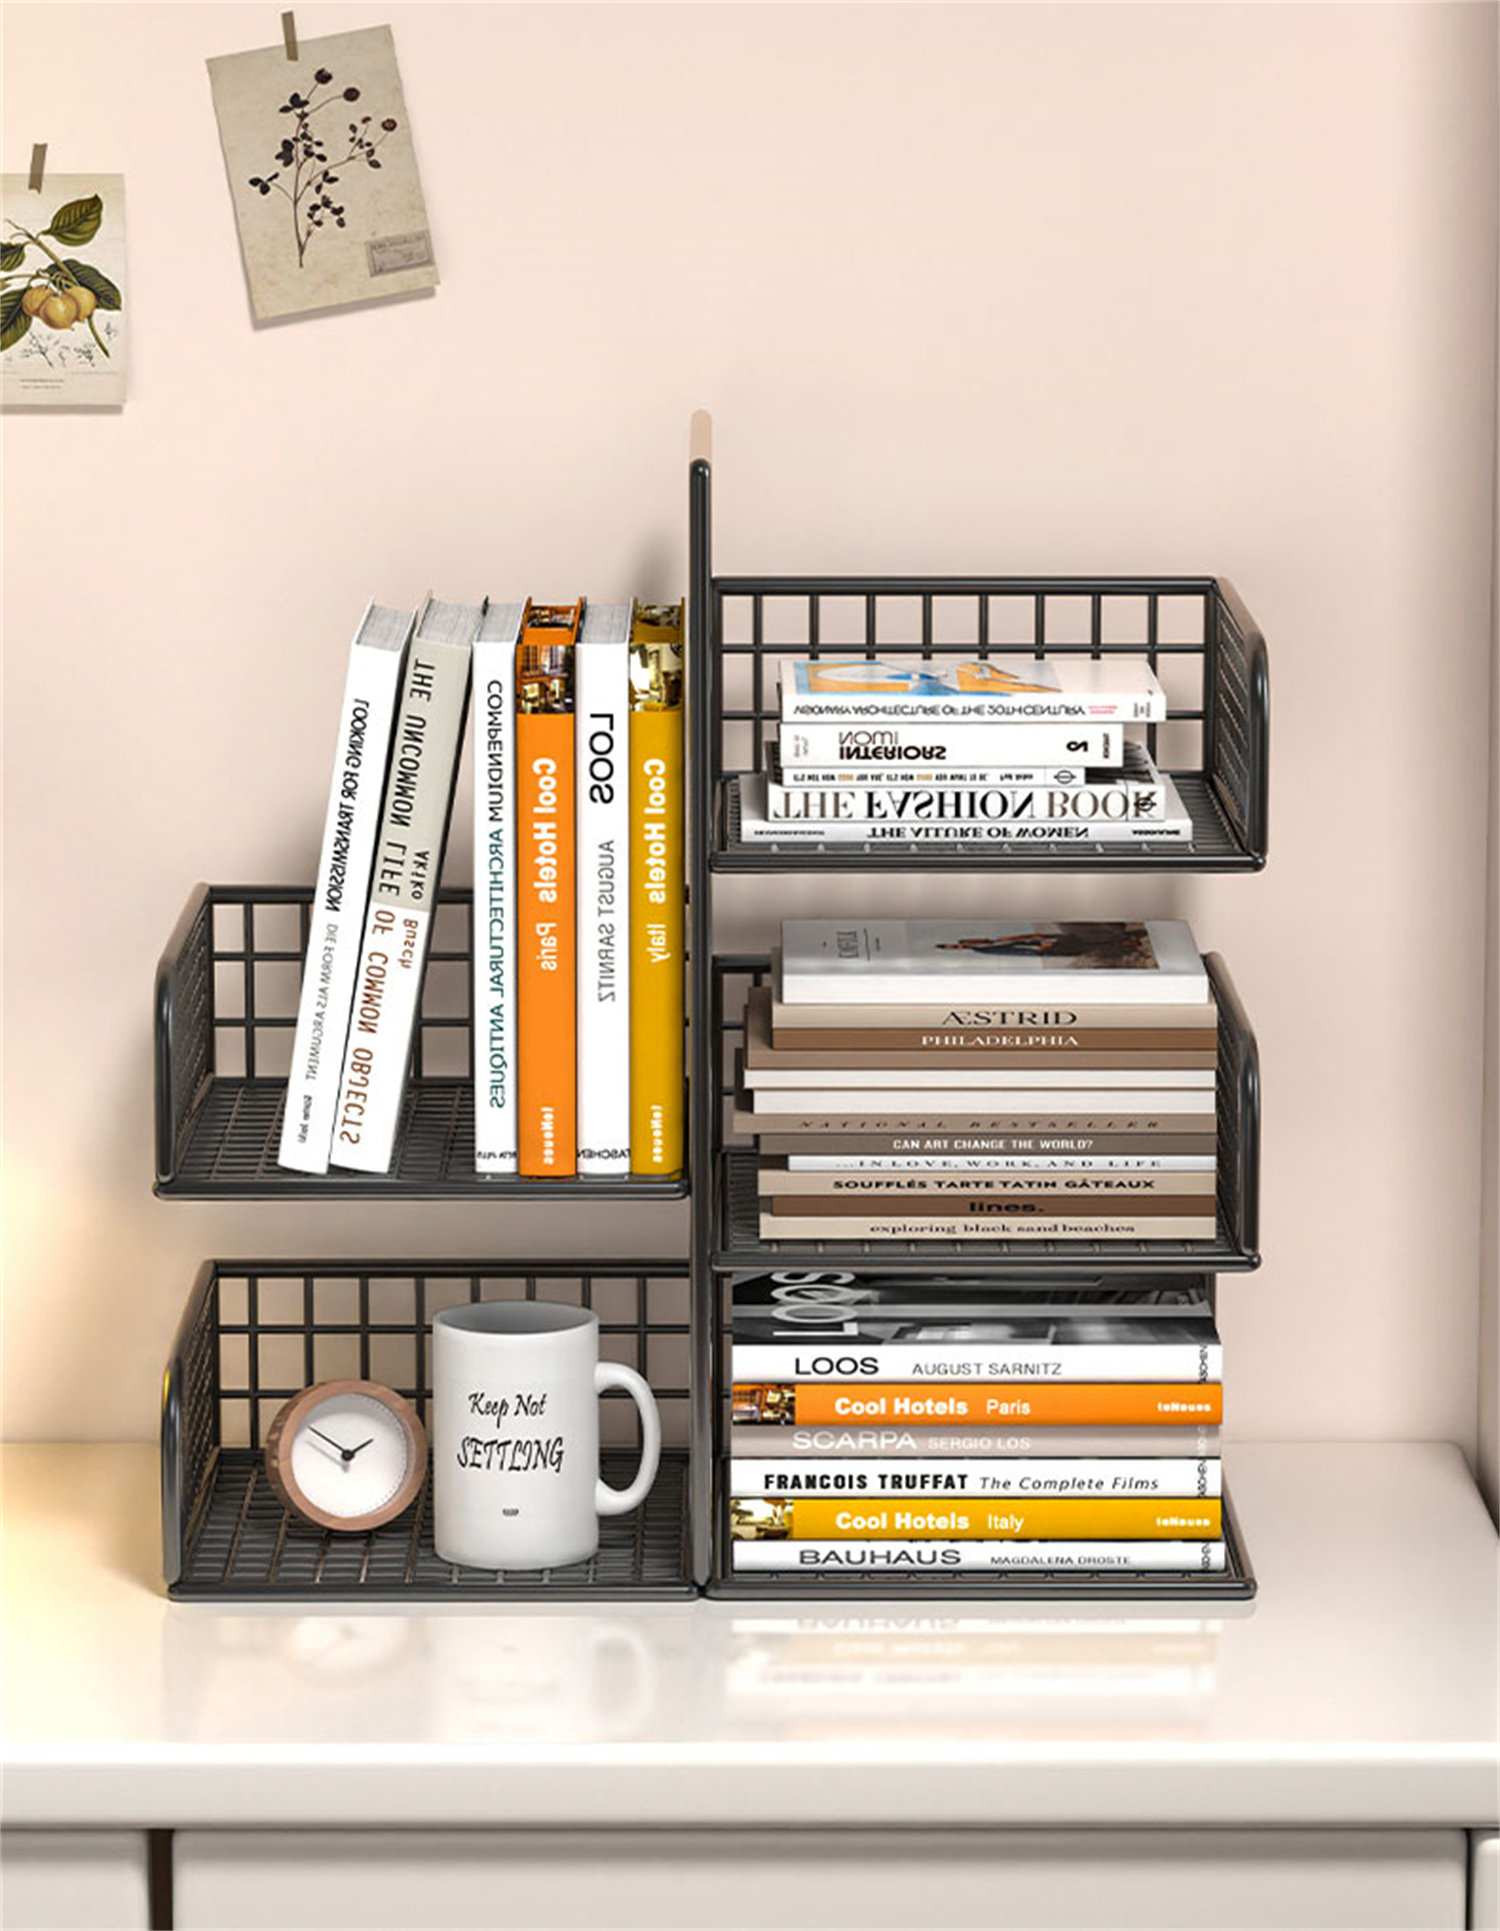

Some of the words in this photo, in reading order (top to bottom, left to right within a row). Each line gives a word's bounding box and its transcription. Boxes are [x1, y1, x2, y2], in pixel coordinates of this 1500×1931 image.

[942, 1010, 1079, 1026] ÆSTRID
[921, 1035, 1079, 1046] PHILADELPHIA
[799, 1120, 946, 1129] NATIONAL
[893, 1139, 920, 1150] CAN
[923, 1139, 949, 1150] ART
[953, 1139, 1006, 1150] CHANGE
[1011, 1139, 1034, 1150] THE
[1039, 1139, 1093, 1150] WORLD?
[1047, 1160, 1093, 1168] AND
[1108, 1160, 1161, 1168] LIFE
[833, 1179, 928, 1189] SOUFFLÉS
[934, 1180, 994, 1189] TARTE
[1000, 1180, 1057, 1189] TATIN
[1064, 1178, 1155, 1189] GÂTEAUX
[969, 1200, 1044, 1213] lines.
[869, 1223, 957, 1235] exploring
[963, 1223, 1011, 1233] black
[1016, 1223, 1059, 1233] sand
[1061, 1223, 1135, 1233] beaches
[794, 1356, 880, 1376] LOOS
[912, 1363, 983, 1376] AUGUST
[988, 1363, 1062, 1376] SARNITZ
[467, 1392, 510, 1429] Keep
[513, 1392, 548, 1417] Not
[834, 1397, 887, 1416] Cool
[893, 1396, 969, 1416] Hotels
[986, 1398, 1031, 1416] Paris
[791, 1432, 918, 1450] SCARPA
[927, 1437, 993, 1451] SERGIO
[997, 1437, 1032, 1450] LOS
[456, 1436, 565, 1474] SETTLING
[764, 1473, 868, 1490] FRANCOIS
[878, 1473, 969, 1490] TRUFFAT
[979, 1477, 1012, 1490] The
[1018, 1477, 1104, 1492] Complete
[1111, 1477, 1159, 1490] Films
[835, 1511, 888, 1530] Cool
[894, 1511, 970, 1530] Hotels
[987, 1513, 1025, 1533] Italy
[799, 1549, 962, 1566] BAUHAUS
[990, 1555, 1072, 1565] MAGDALENA
[1076, 1555, 1132, 1565] DROSTE
